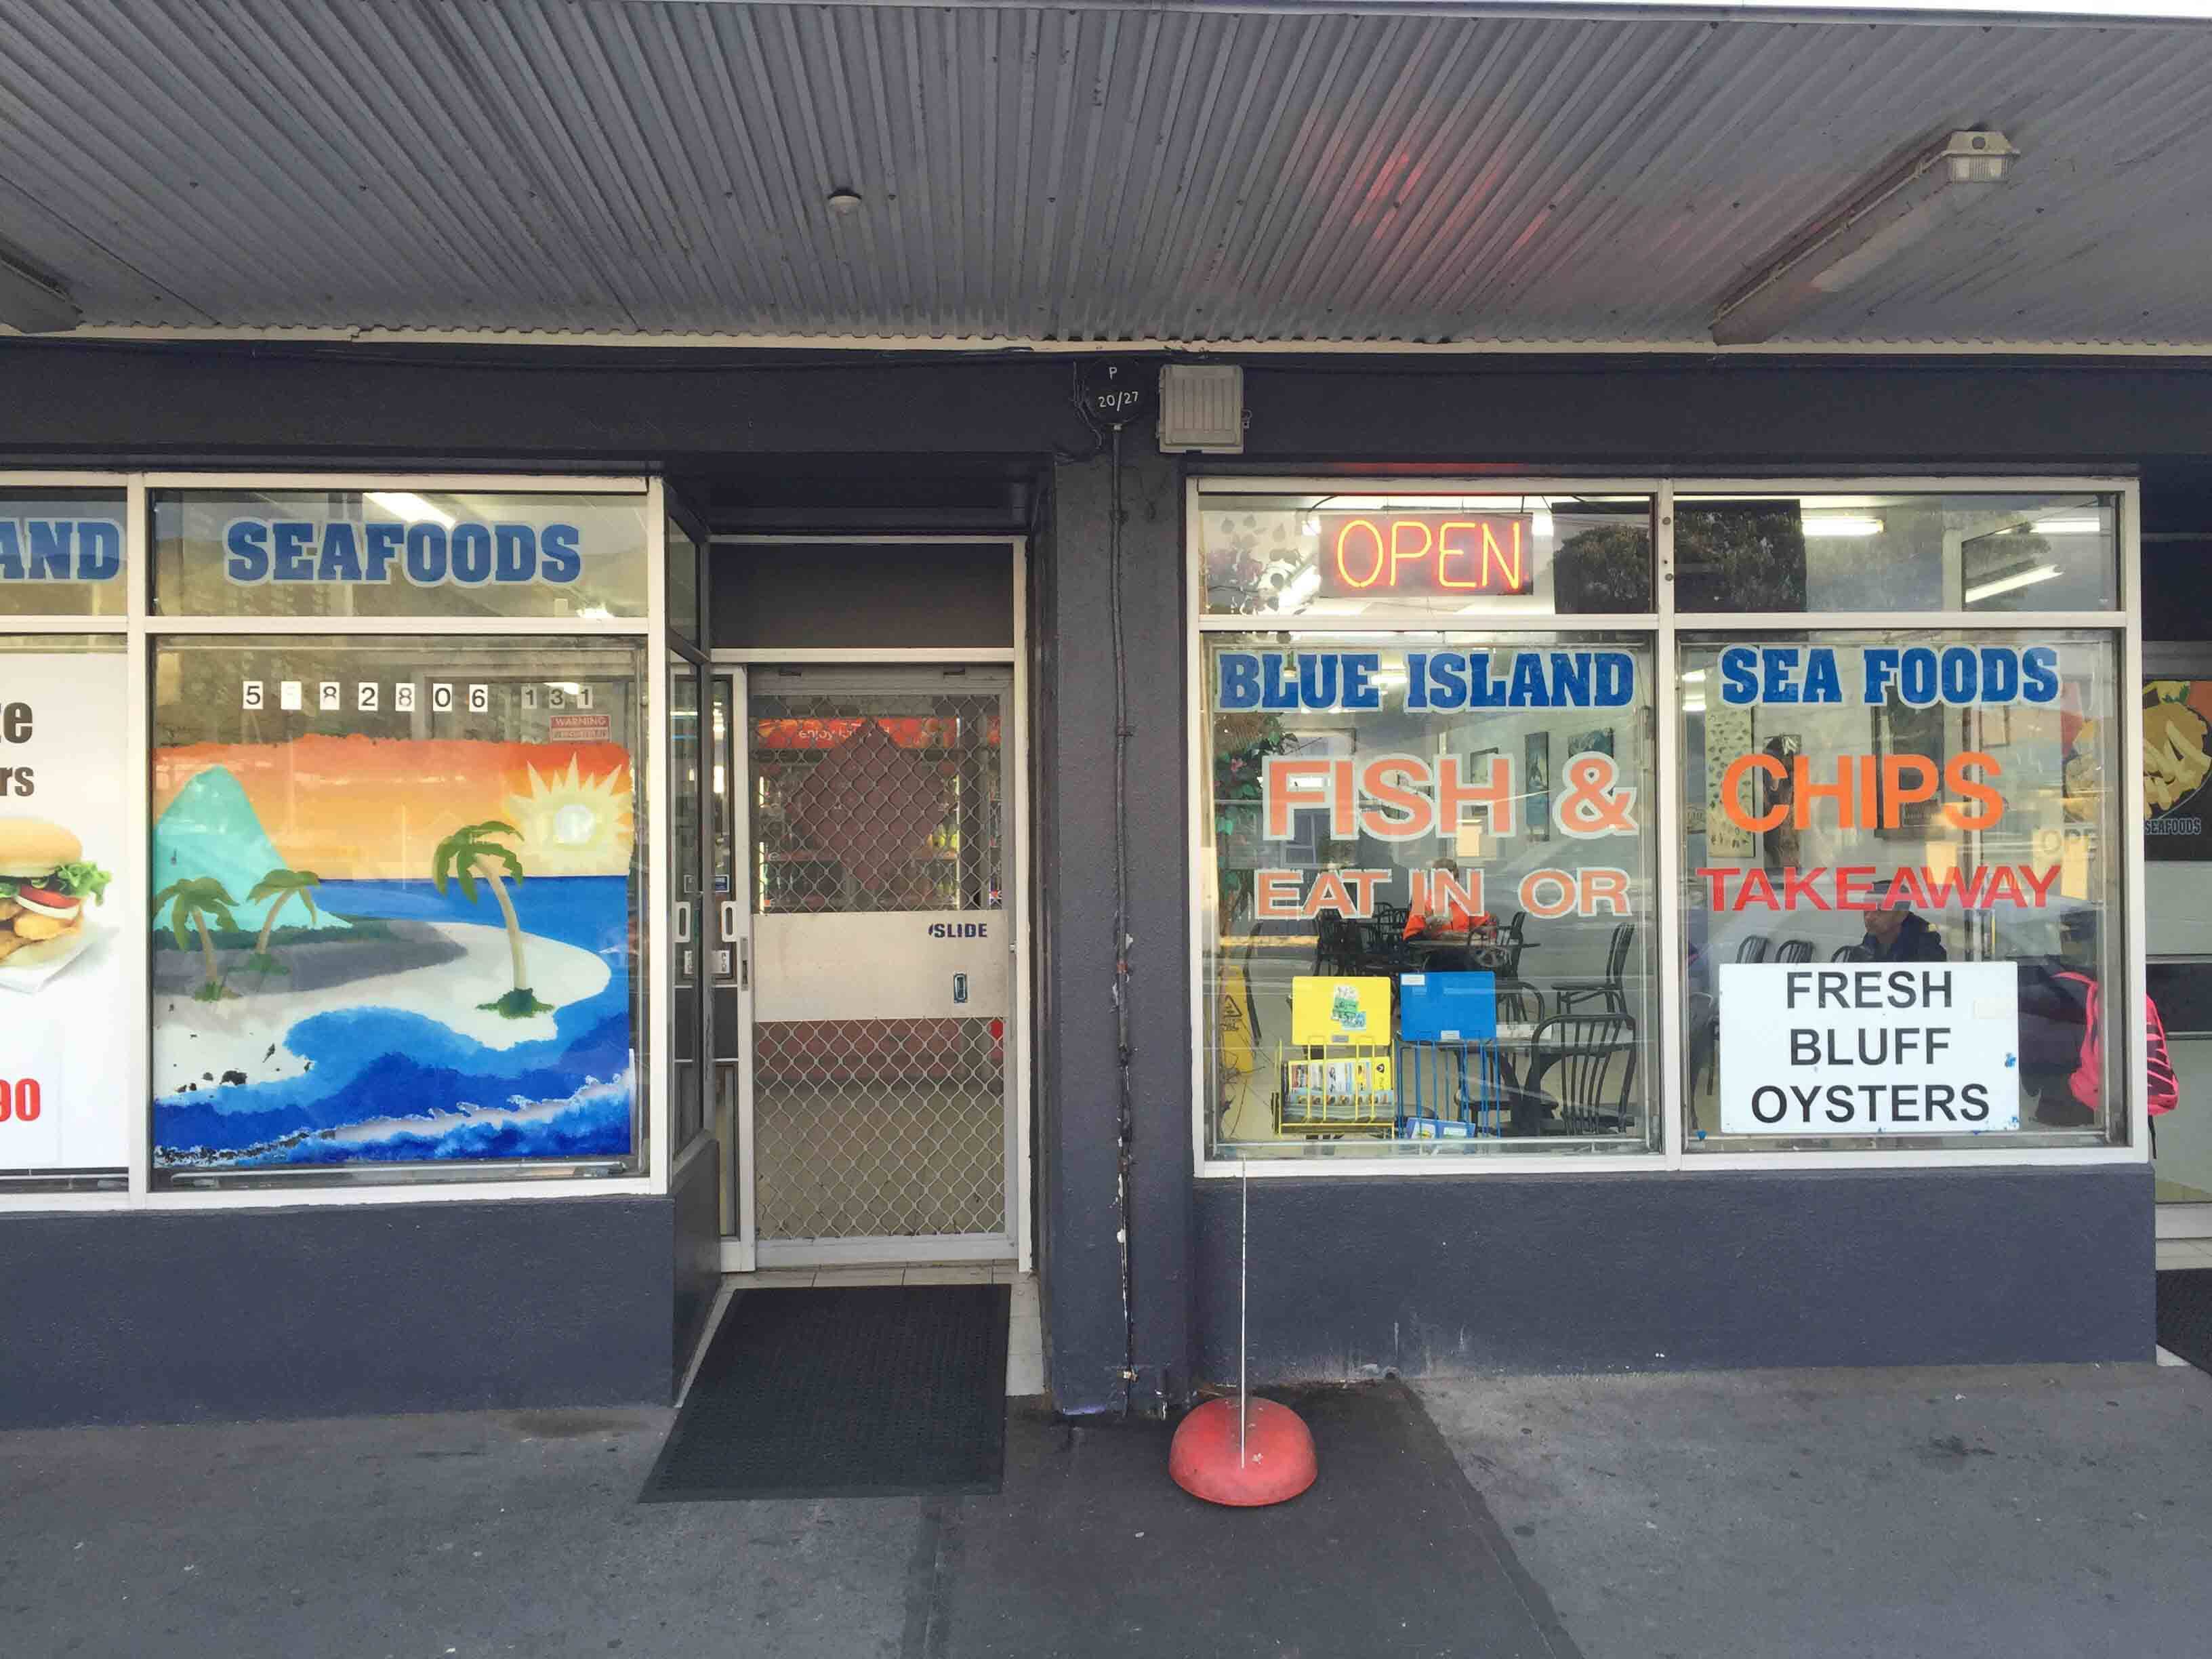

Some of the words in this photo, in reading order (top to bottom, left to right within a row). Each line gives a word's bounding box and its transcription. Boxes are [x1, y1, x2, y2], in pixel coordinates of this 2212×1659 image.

[1108, 367, 1118, 380] P
[1097, 390, 1139, 412] 20/27
[225, 520, 583, 583] SEAFOODS
[1336, 519, 1521, 590] OPEN
[1218, 652, 1381, 709] BLUE
[1406, 651, 1635, 708] ISLAND
[1720, 647, 1843, 704] SEA
[1864, 646, 2060, 704] FOODS
[0, 701, 33, 744] e
[1267, 757, 1512, 838] FISH
[1558, 756, 1638, 836] &
[1721, 752, 2004, 832] CHIPS
[2144, 817, 2201, 836] SEAFOODS
[1256, 869, 1391, 918] EAT
[1409, 869, 1484, 918] IN
[1518, 868, 1632, 918] OR
[1696, 863, 2062, 912] TAKEAWAY
[933, 922, 987, 939] SLIDE
[1786, 970, 1952, 1010] FRESH
[1789, 1027, 1952, 1067] BLUFF
[1750, 1082, 1990, 1124] OYSTERS
